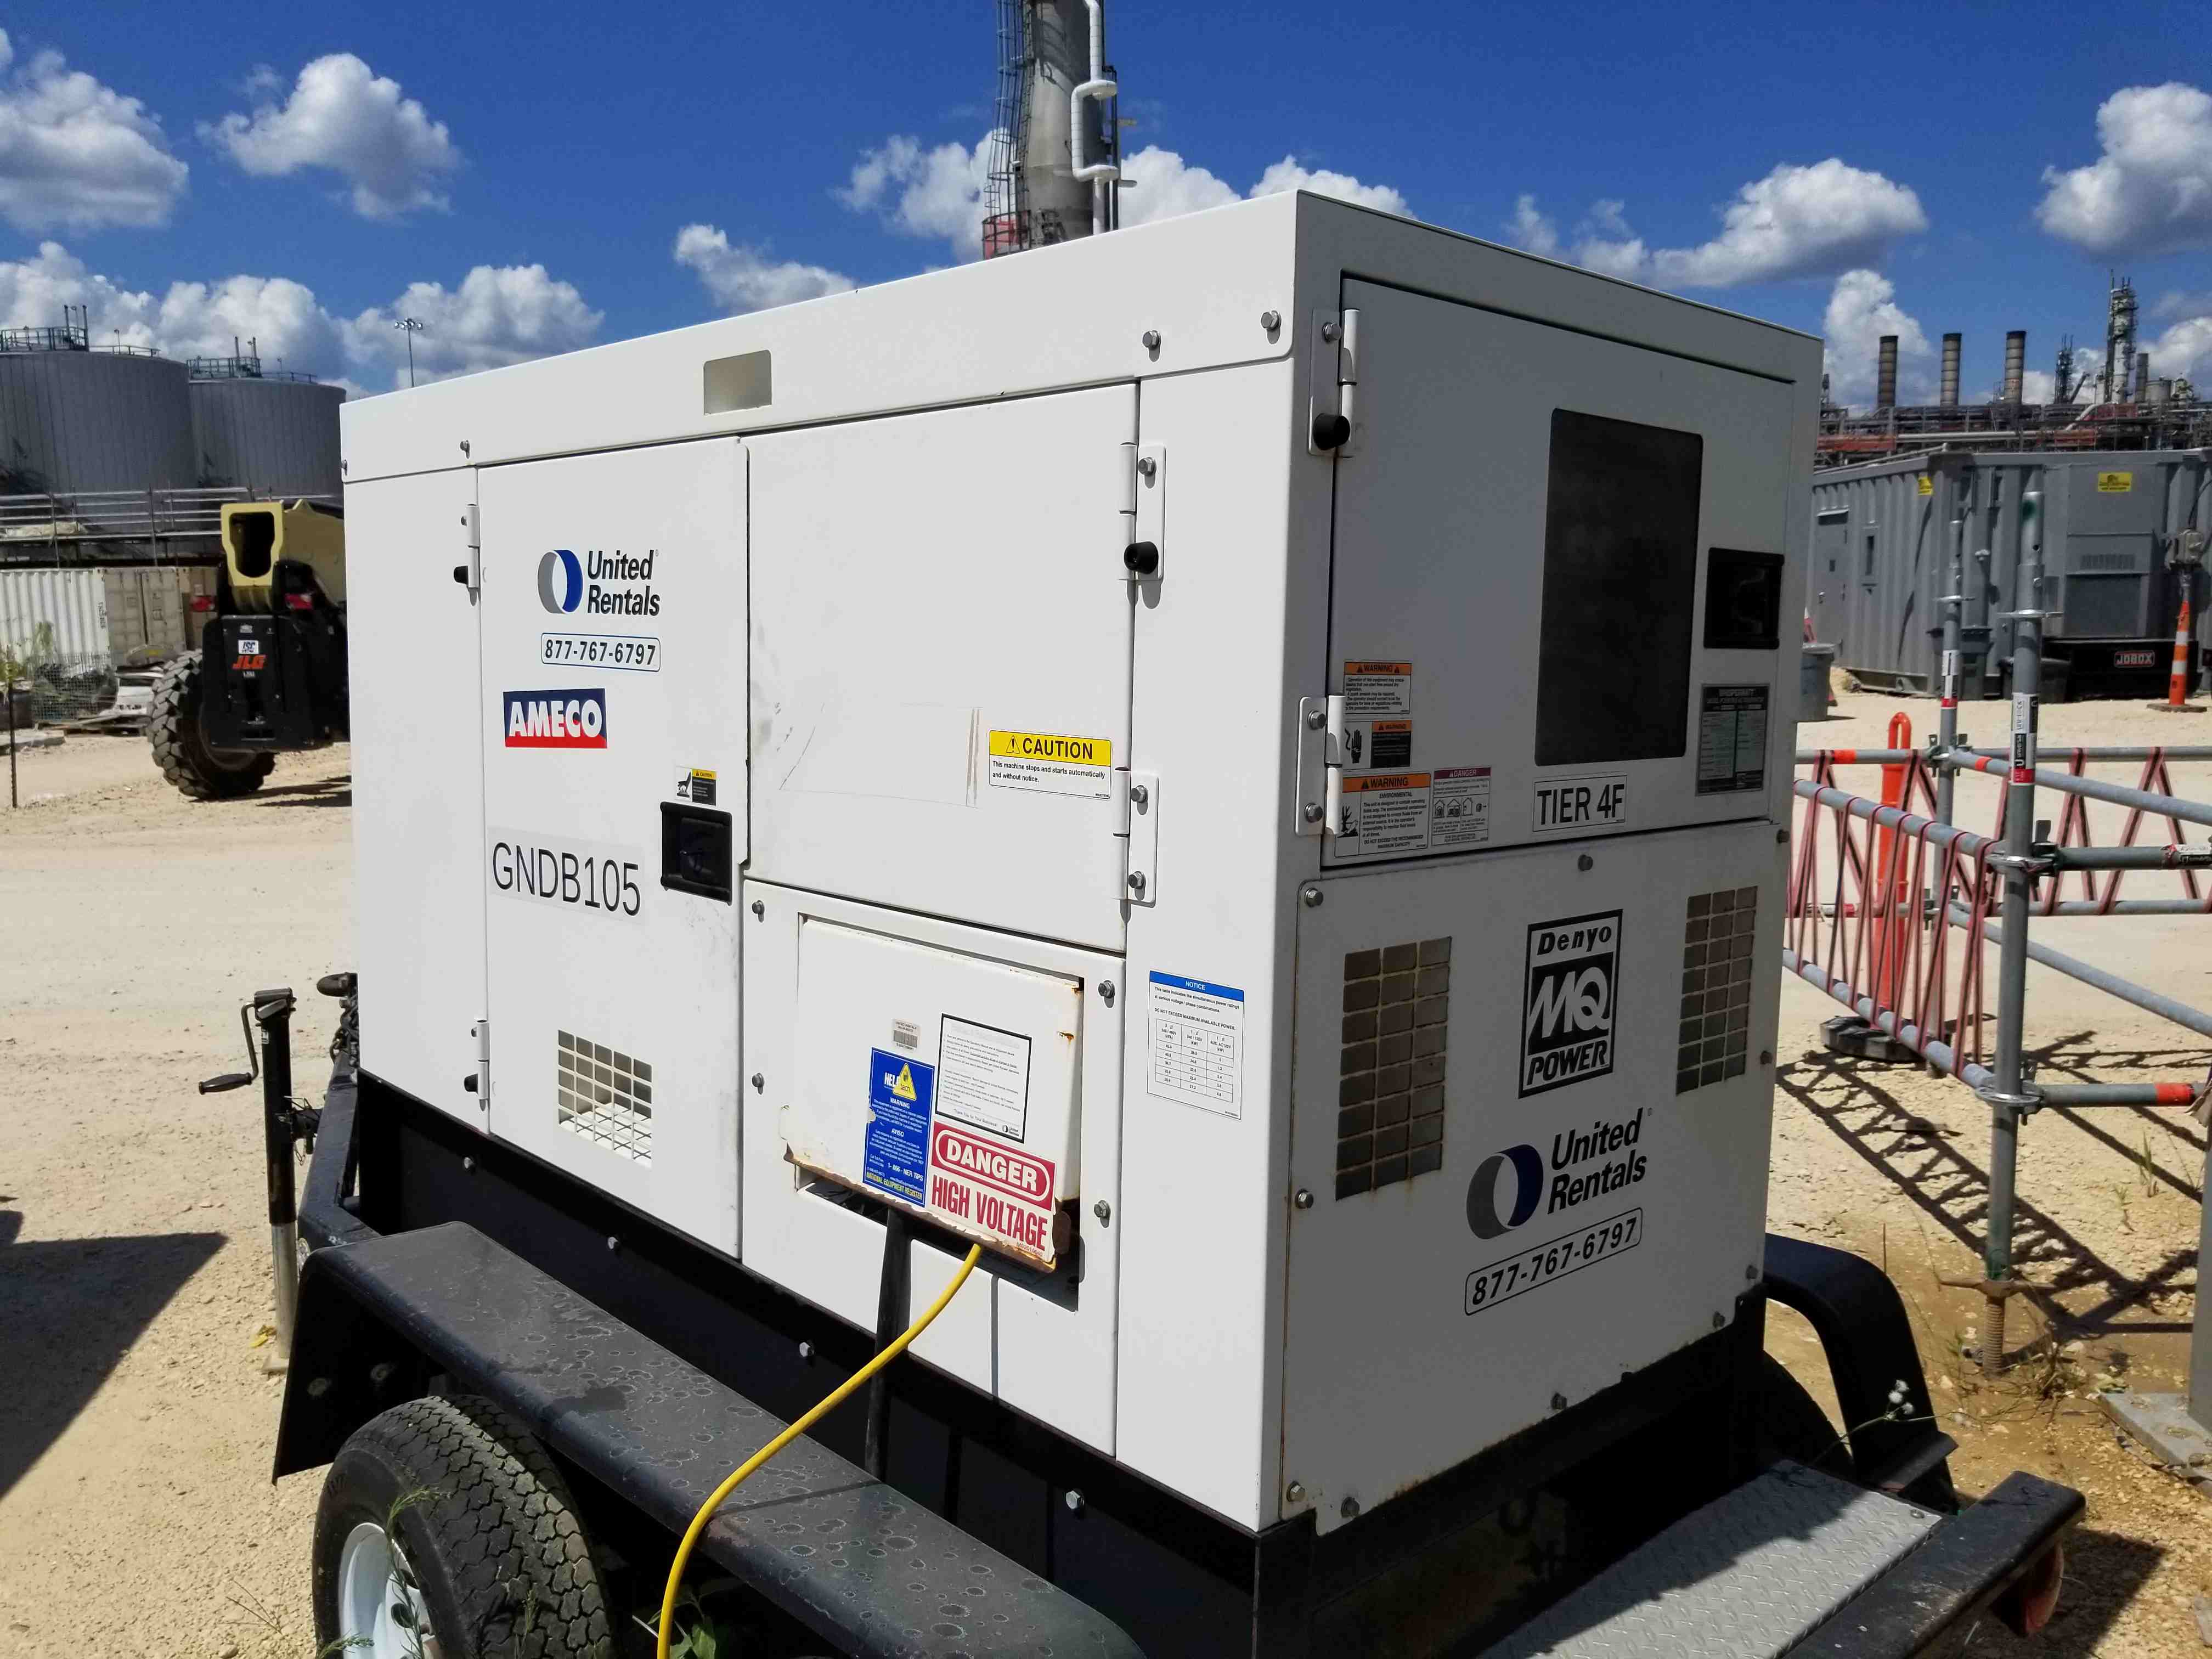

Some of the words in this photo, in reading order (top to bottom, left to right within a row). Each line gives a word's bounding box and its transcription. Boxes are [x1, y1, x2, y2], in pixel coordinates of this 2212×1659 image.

[588, 549, 654, 580] United
[588, 584, 661, 616] Rentals
[232, 654, 267, 670] JLG
[545, 639, 656, 665] 877-767-6797
[509, 699, 602, 738] AMECO
[1023, 737, 1092, 760] CAUTION
[1069, 769, 1105, 779] automatically
[1370, 776, 1409, 788] WARNING
[1453, 769, 1477, 777] DANGER
[1537, 787, 1591, 825] TIER
[1596, 783, 1624, 819] 4F
[493, 842, 640, 916] GNDB105
[1536, 926, 1612, 956] Denyo
[1185, 980, 1206, 990] NOTICE
[1527, 966, 1609, 1040] MQ
[1200, 1018, 1221, 1027] AVAILABLE
[1526, 1039, 1608, 1086] POWER
[890, 1097, 910, 1109] WARNING
[1551, 1107, 1644, 1171] United
[903, 1168, 913, 1177] NER
[913, 1172, 924, 1181] TIPS
[946, 1138, 1037, 1192] DANGER
[1547, 1149, 1646, 1215] Rentals
[932, 1174, 970, 1219] HIGH
[976, 1190, 1048, 1251] VOLTAGE
[1472, 1216, 1637, 1306] 877-767-6797
